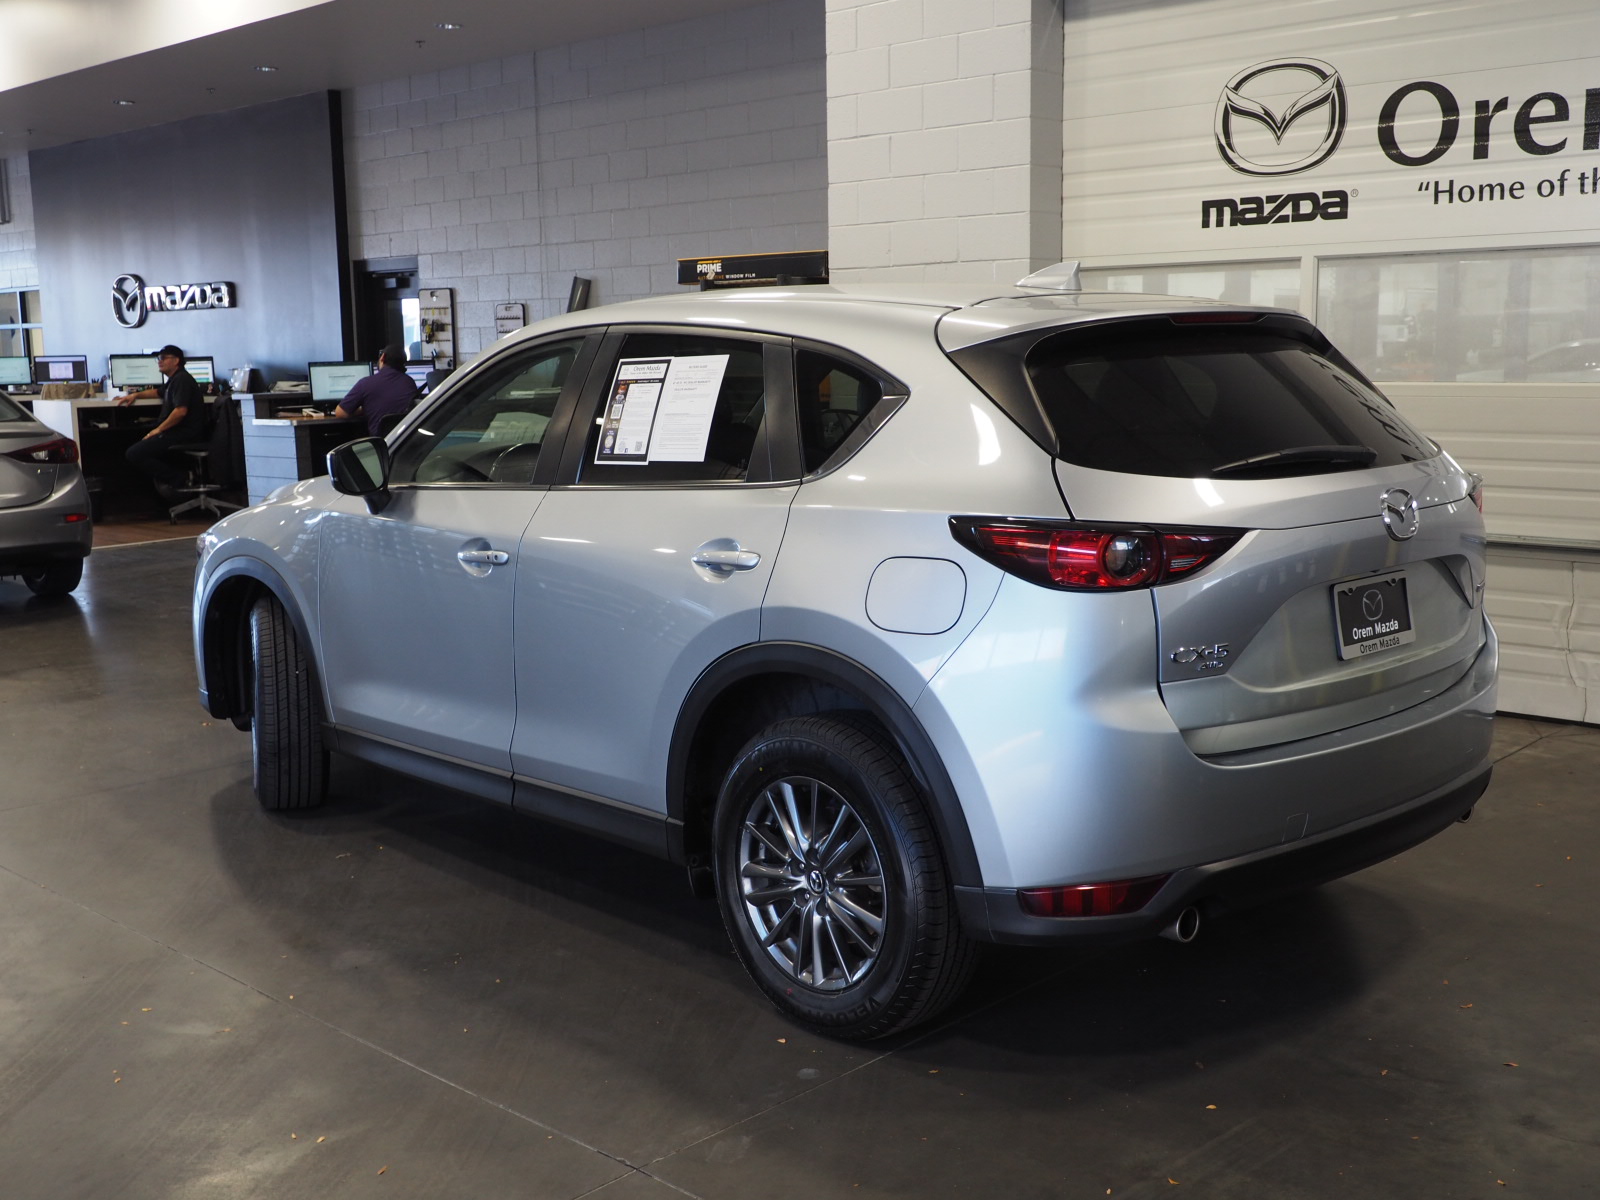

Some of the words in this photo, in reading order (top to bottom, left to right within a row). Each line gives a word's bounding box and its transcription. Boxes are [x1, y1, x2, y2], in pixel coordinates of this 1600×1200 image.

[1377, 81, 1600, 167] Ore
[1536, 168, 1571, 198] of
[696, 263, 722, 273] PRIME
[1352, 625, 1374, 640] Orem
[1374, 618, 1399, 635] Mazda
[1170, 642, 1229, 664] CX-5
[1360, 641, 1379, 654] Orem
[1380, 635, 1400, 648] Mazda
